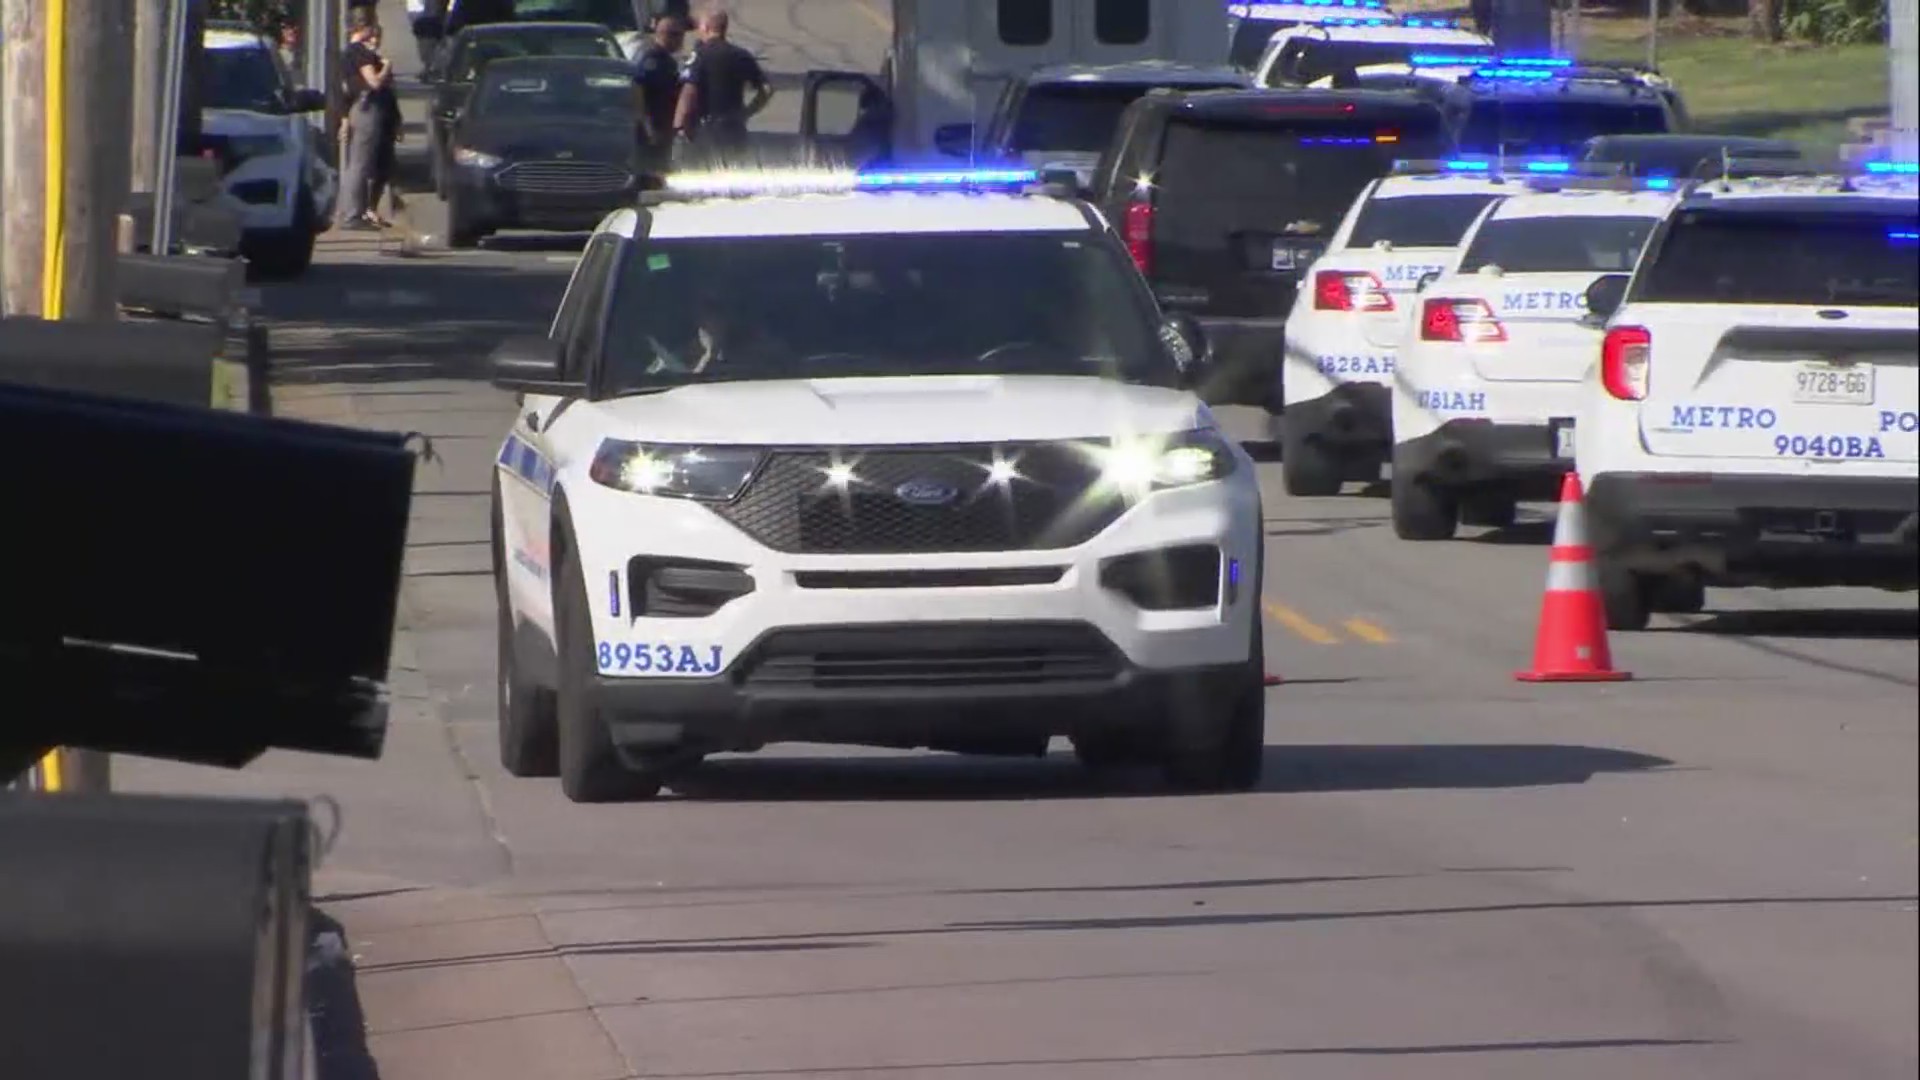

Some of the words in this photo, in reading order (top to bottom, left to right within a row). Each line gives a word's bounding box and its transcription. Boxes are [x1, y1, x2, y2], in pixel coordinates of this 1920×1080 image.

[1385, 265, 1444, 280] MET
[1797, 371, 1866, 393] 9728-GG
[1672, 406, 1776, 429] METRO
[1880, 410, 1919, 432] PO
[1774, 435, 1885, 458] 9040BA
[598, 642, 722, 672] 8953AJ
